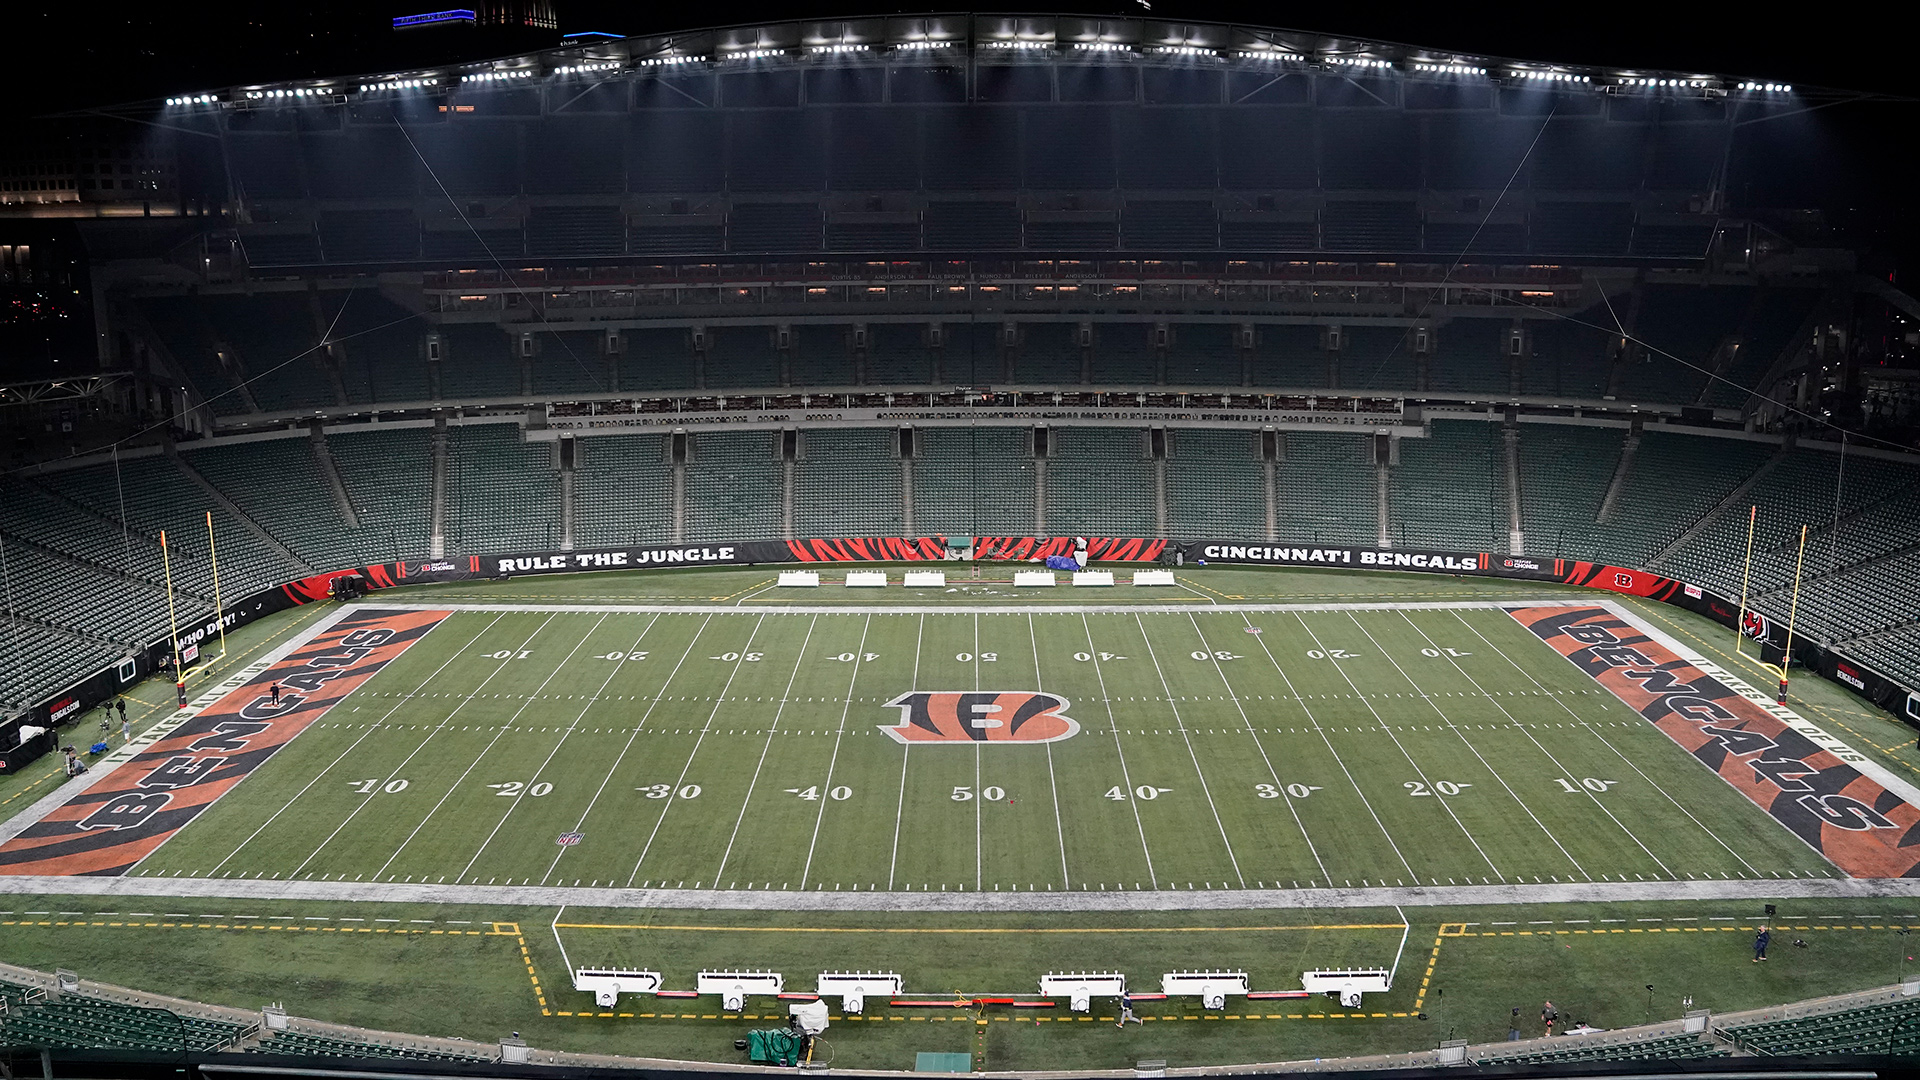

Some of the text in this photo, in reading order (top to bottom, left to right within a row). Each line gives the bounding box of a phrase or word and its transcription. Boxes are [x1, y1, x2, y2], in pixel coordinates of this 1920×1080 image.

[499, 546, 736, 573] RULE THE JUNGLE
[1204, 545, 1478, 572] CINCINNATI BENGALS
[1614, 572, 1633, 588] B
[176, 612, 236, 651] WHO DEY!
[493, 649, 534, 660] 10
[606, 650, 649, 661] 20
[721, 651, 764, 662] 30
[837, 651, 881, 663] 40
[956, 651, 998, 663] 50
[1073, 651, 1117, 662] 40
[1191, 649, 1235, 661] 30
[1306, 648, 1352, 660] 20
[1421, 646, 1466, 658] 10
[1836, 669, 1865, 690] BENGALS.COM
[50, 700, 80, 723] BENGALS.COM
[104, 661, 272, 763] IT TAKES ALL OF US
[1688, 658, 1867, 763] IT TAKES ALL OF US
[75, 628, 398, 831] BENGALS
[1558, 624, 1901, 831] BENGALS
[353, 778, 410, 795] 10
[496, 781, 554, 797] 20
[645, 783, 702, 800] 30
[797, 785, 853, 801] 40
[950, 785, 1006, 801] 50
[1104, 785, 1160, 801] 40
[1255, 783, 1311, 799] 30
[1403, 780, 1461, 796] 20
[1553, 777, 1610, 794] 10
